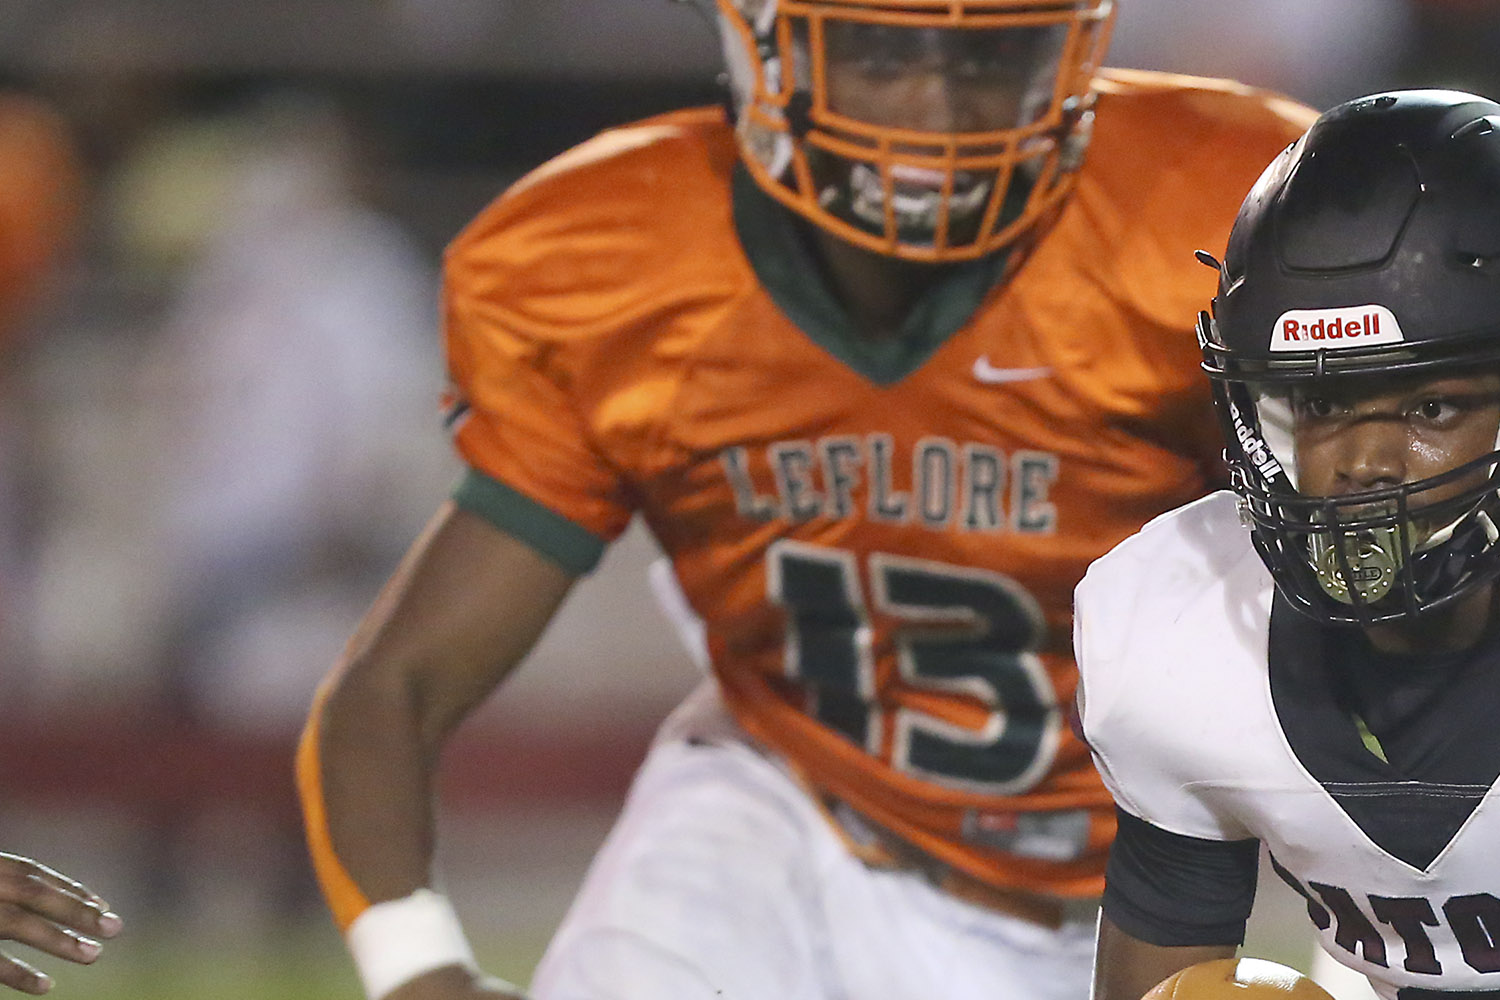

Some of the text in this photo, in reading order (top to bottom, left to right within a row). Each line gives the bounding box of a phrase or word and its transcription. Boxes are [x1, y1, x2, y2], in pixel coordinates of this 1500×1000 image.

[1283, 313, 1380, 341] Riddell
[719, 433, 1060, 535] LEFLORE
[767, 538, 1063, 795] 13
